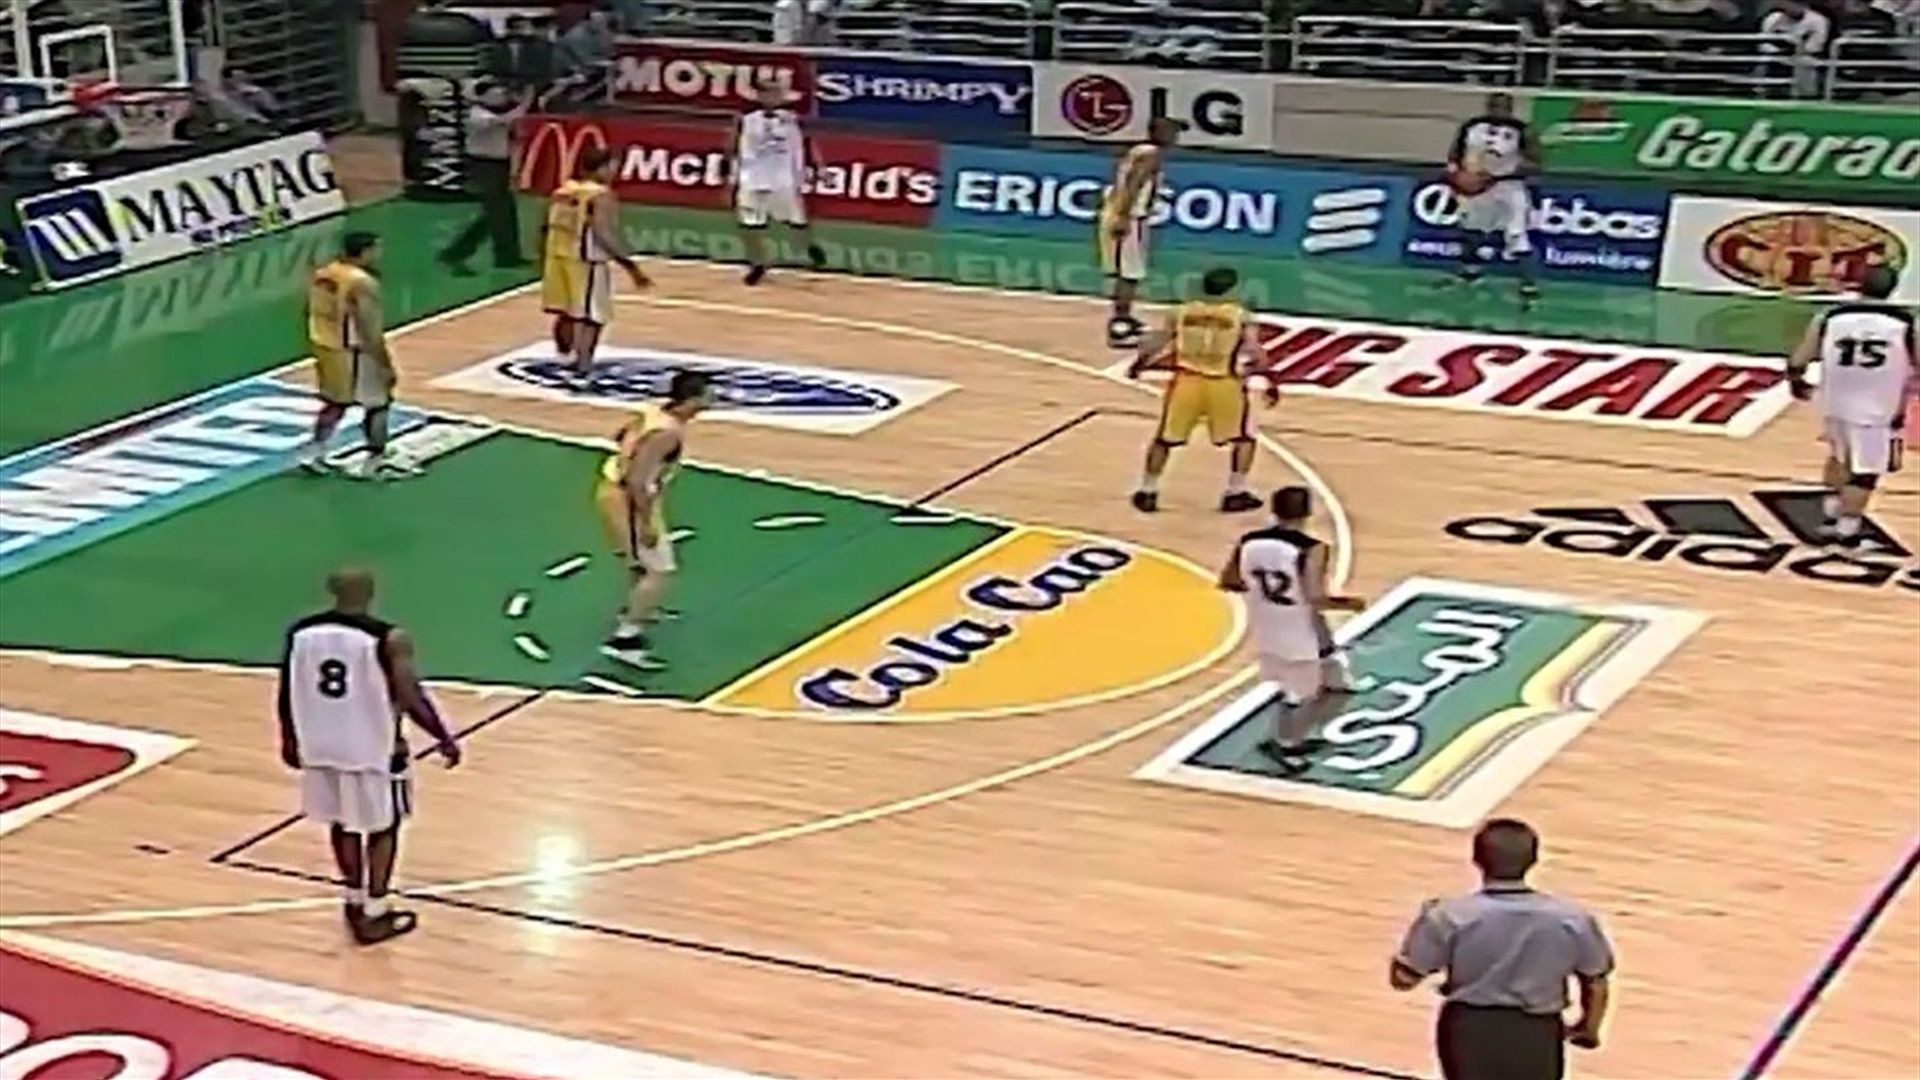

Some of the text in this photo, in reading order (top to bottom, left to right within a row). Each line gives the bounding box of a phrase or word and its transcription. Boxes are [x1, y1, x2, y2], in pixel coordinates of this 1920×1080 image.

[117, 150, 338, 242] MAYTAG
[954, 169, 1277, 234] ERICSON
[1386, 344, 1788, 426] STAR
[1834, 338, 1890, 368] 15
[1250, 569, 1296, 606] 12
[798, 544, 1132, 711] Cola Cao
[318, 658, 347, 700] 8
